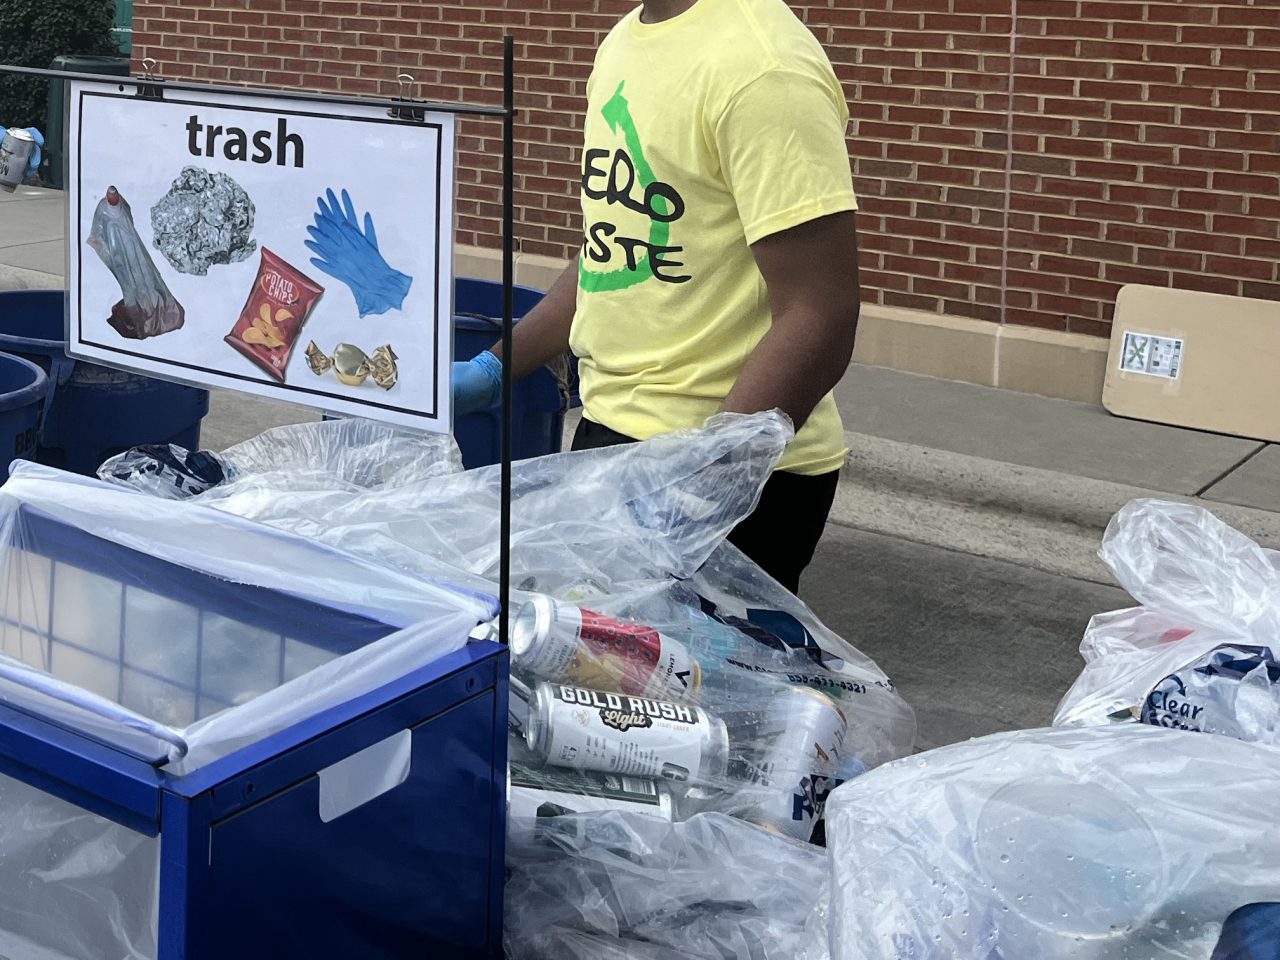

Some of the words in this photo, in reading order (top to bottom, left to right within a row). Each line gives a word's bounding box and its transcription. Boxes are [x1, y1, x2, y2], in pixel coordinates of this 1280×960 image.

[185, 115, 305, 168] trash
[582, 148, 685, 223] ERO
[587, 222, 692, 283] STE
[265, 271, 293, 294] POTATO
[268, 286, 293, 305] CHIPS
[560, 685, 622, 711] GOLD
[629, 696, 696, 725] RUSH
[604, 709, 646, 730] Light
[1147, 689, 1204, 720] Clear
